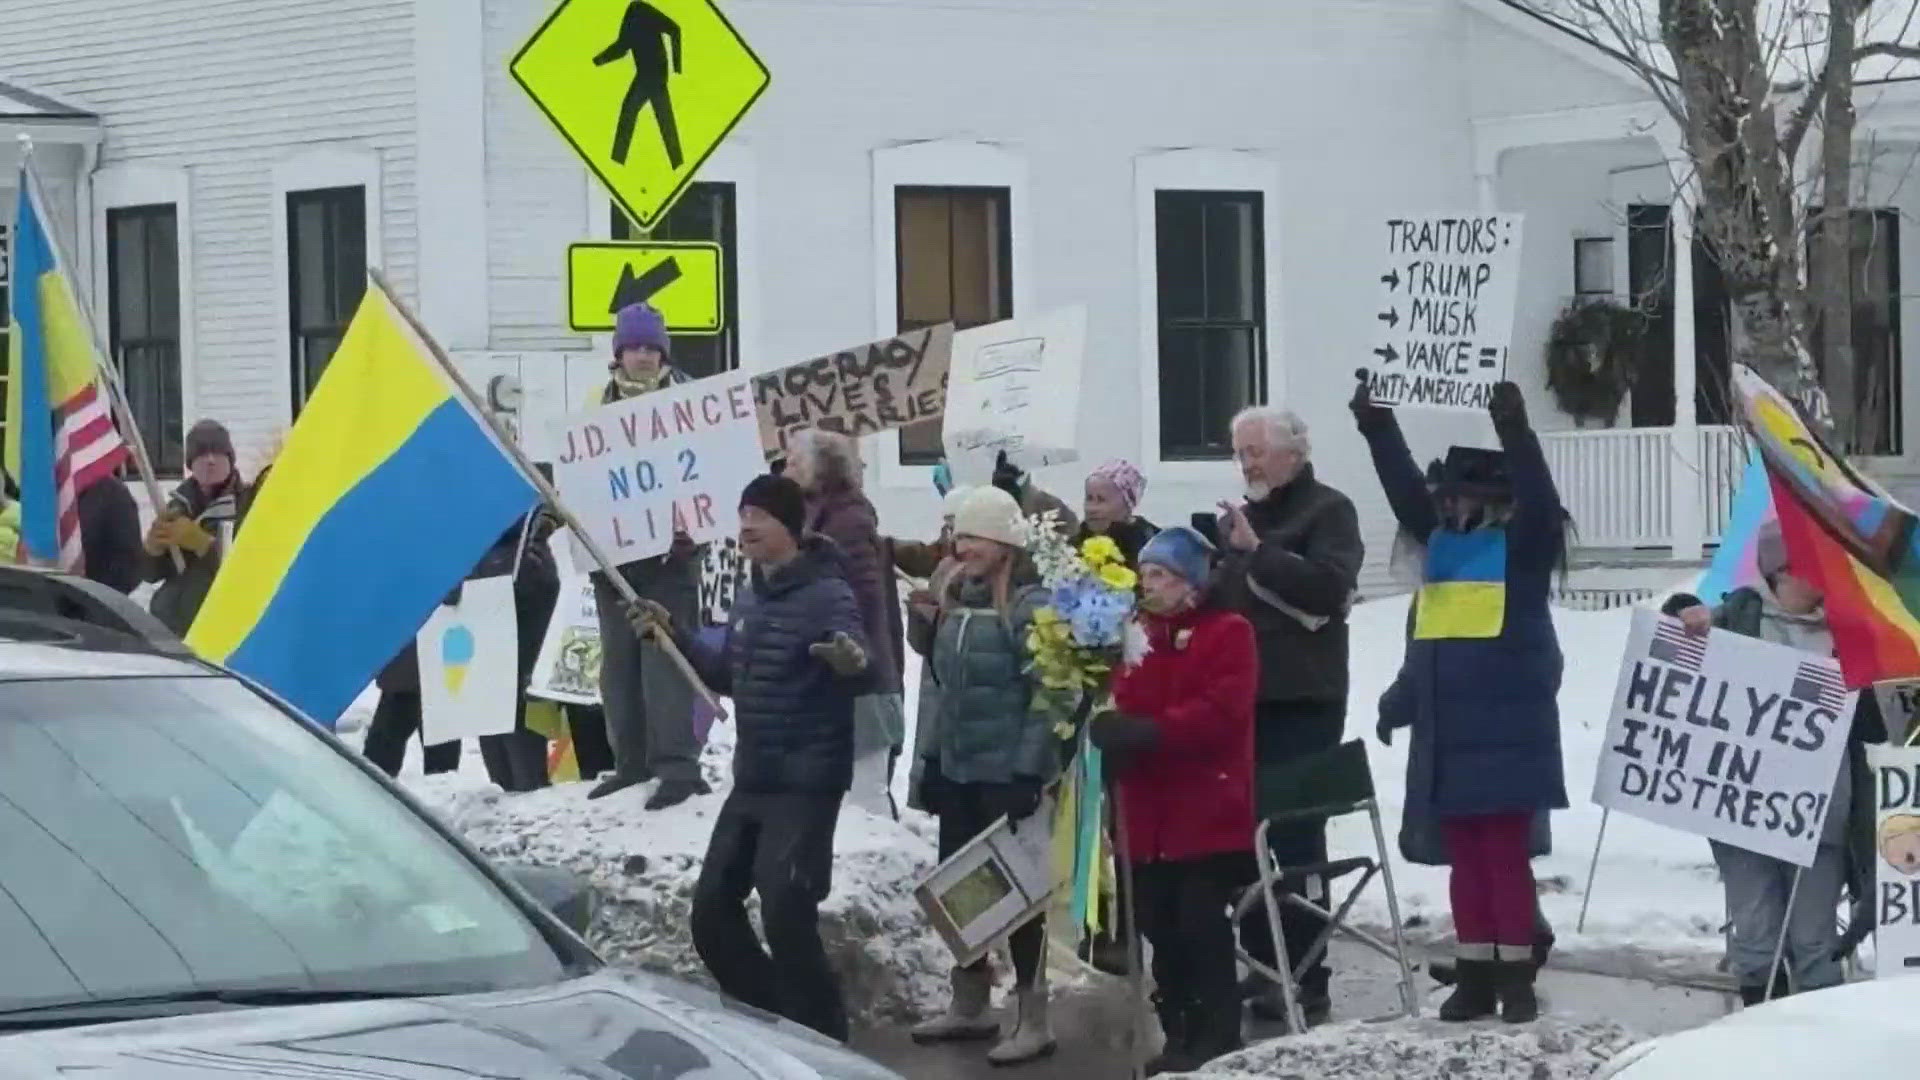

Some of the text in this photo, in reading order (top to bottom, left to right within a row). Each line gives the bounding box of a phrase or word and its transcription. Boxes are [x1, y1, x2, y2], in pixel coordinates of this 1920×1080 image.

[1407, 261, 1491, 299] TRUMP
[1409, 298, 1477, 336] MUSK
[1406, 341, 1473, 375] VANCE
[559, 383, 751, 464] J.D. VANCE
[771, 373, 890, 427] LIVES
[608, 448, 699, 501] NO. 2
[612, 493, 716, 548] LIAR
[1626, 661, 1730, 732] HELL
[1745, 686, 1839, 752] YES
[1613, 718, 1762, 785] I'M IN
[1620, 763, 1829, 840] DISTRESS!
